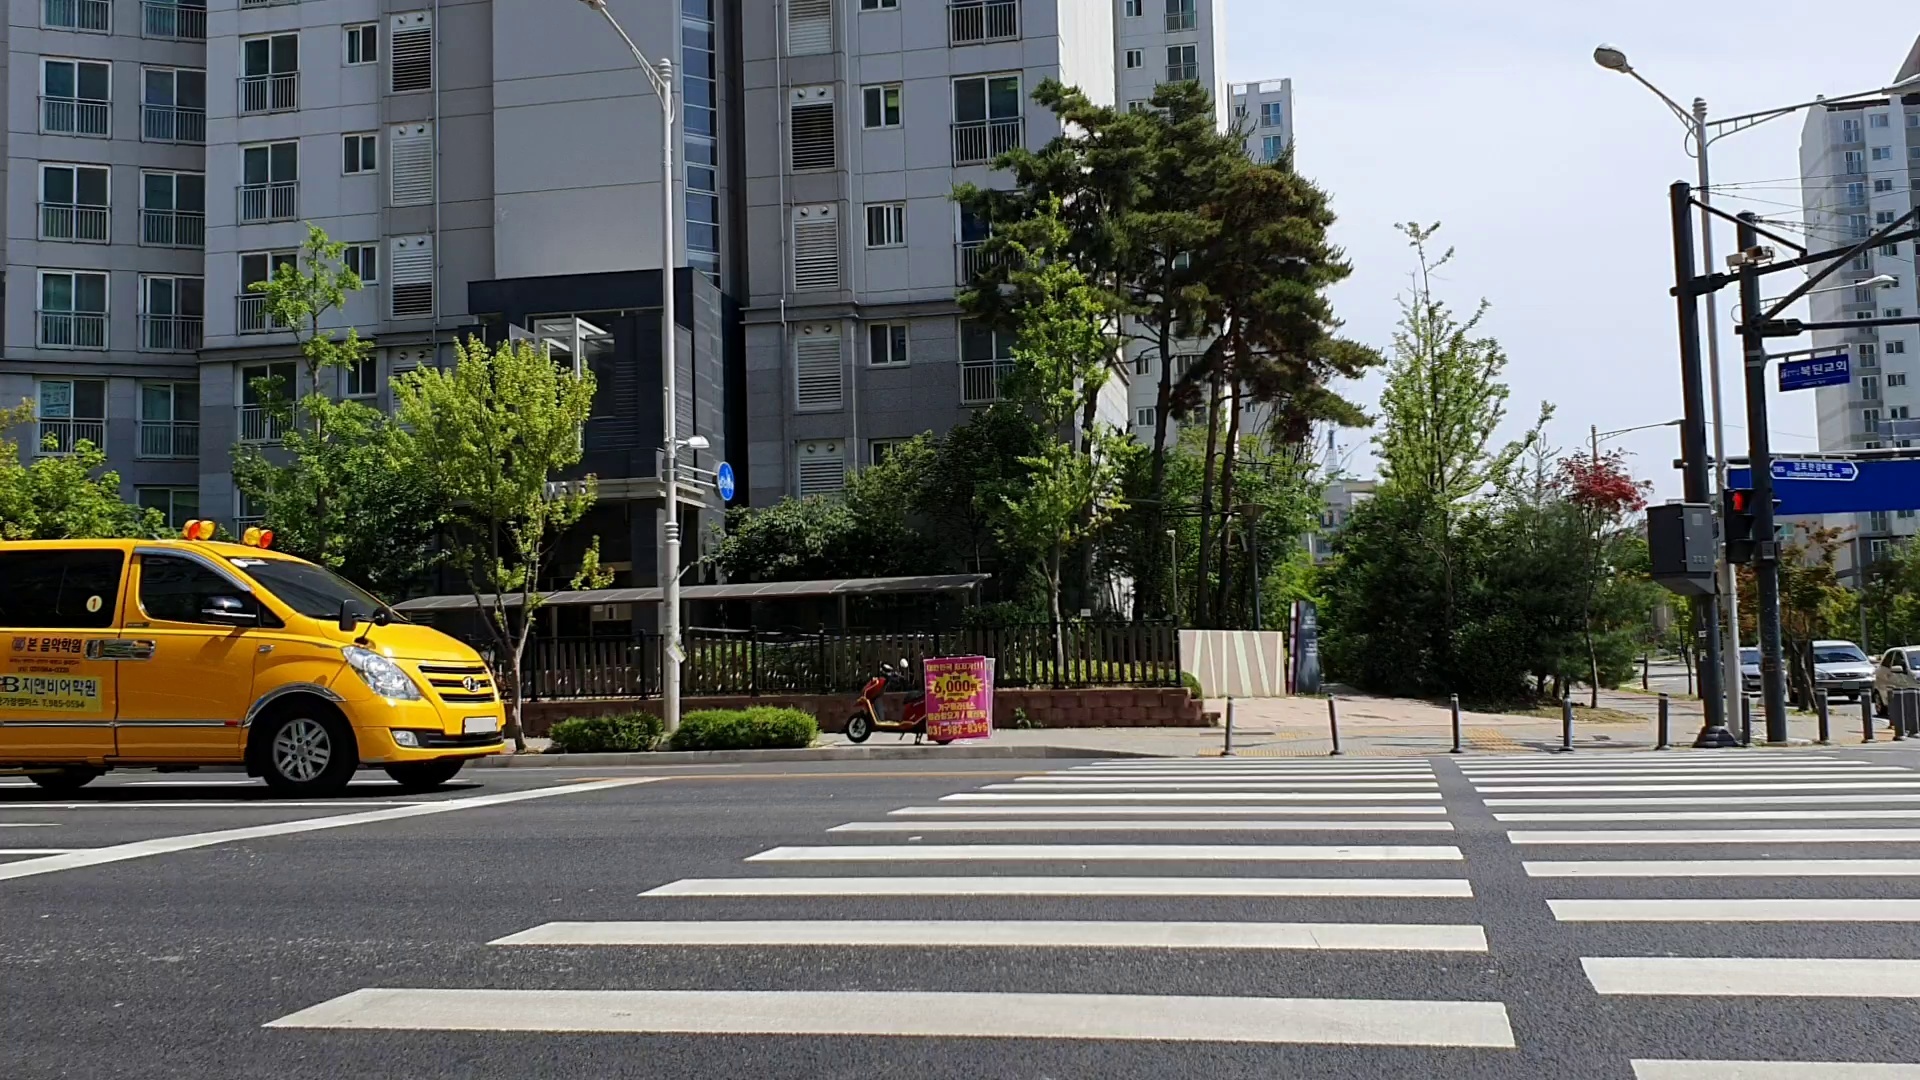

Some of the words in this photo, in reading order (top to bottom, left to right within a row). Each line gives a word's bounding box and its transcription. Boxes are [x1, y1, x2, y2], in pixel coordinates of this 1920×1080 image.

[92, 598, 97, 610] 1
[27, 638, 37, 652] 본
[41, 638, 82, 653] 음악학원
[22, 678, 96, 696] 지앤비어학원
